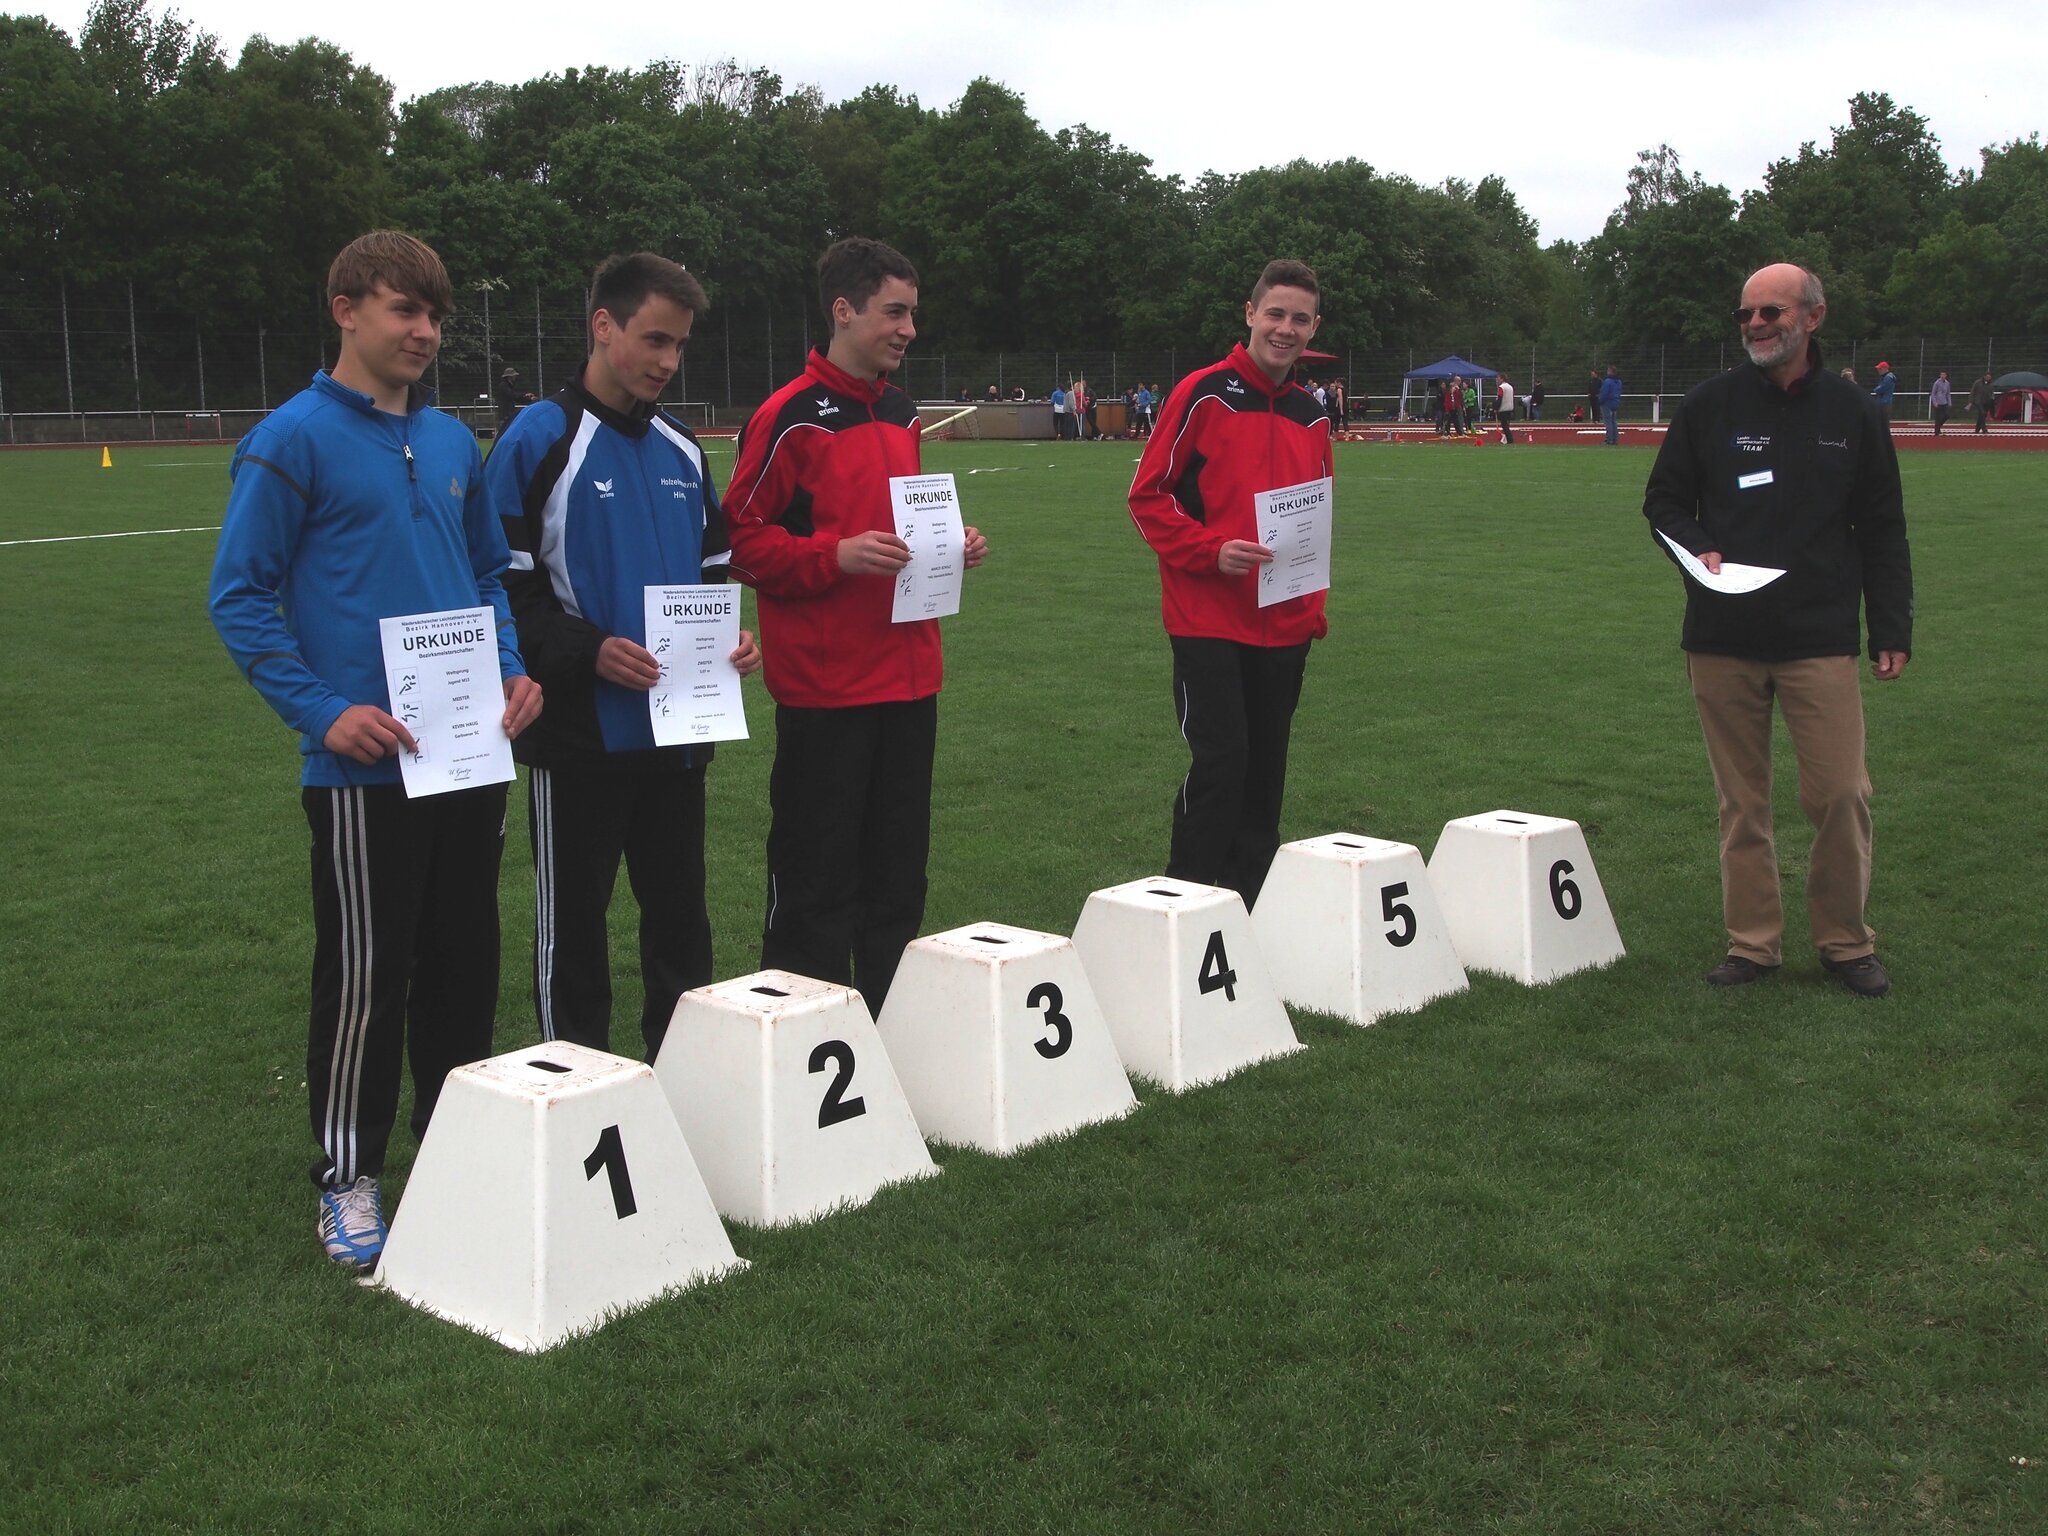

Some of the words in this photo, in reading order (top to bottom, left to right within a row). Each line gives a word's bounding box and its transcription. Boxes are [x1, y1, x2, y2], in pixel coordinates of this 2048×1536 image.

[818, 406, 840, 416] erima
[905, 490, 952, 505] URKUNDE
[1270, 492, 1325, 514] URKUNDE
[663, 603, 731, 616] URKUNDE
[403, 628, 485, 651] URKUNDE
[419, 647, 474, 659] Bezirksmeisterschaften
[1549, 859, 1582, 920] 6
[1380, 882, 1417, 948] 5
[1198, 930, 1236, 1002] 4
[1026, 982, 1072, 1060] 3
[808, 1039, 866, 1129] 2
[583, 1124, 637, 1220] 1
